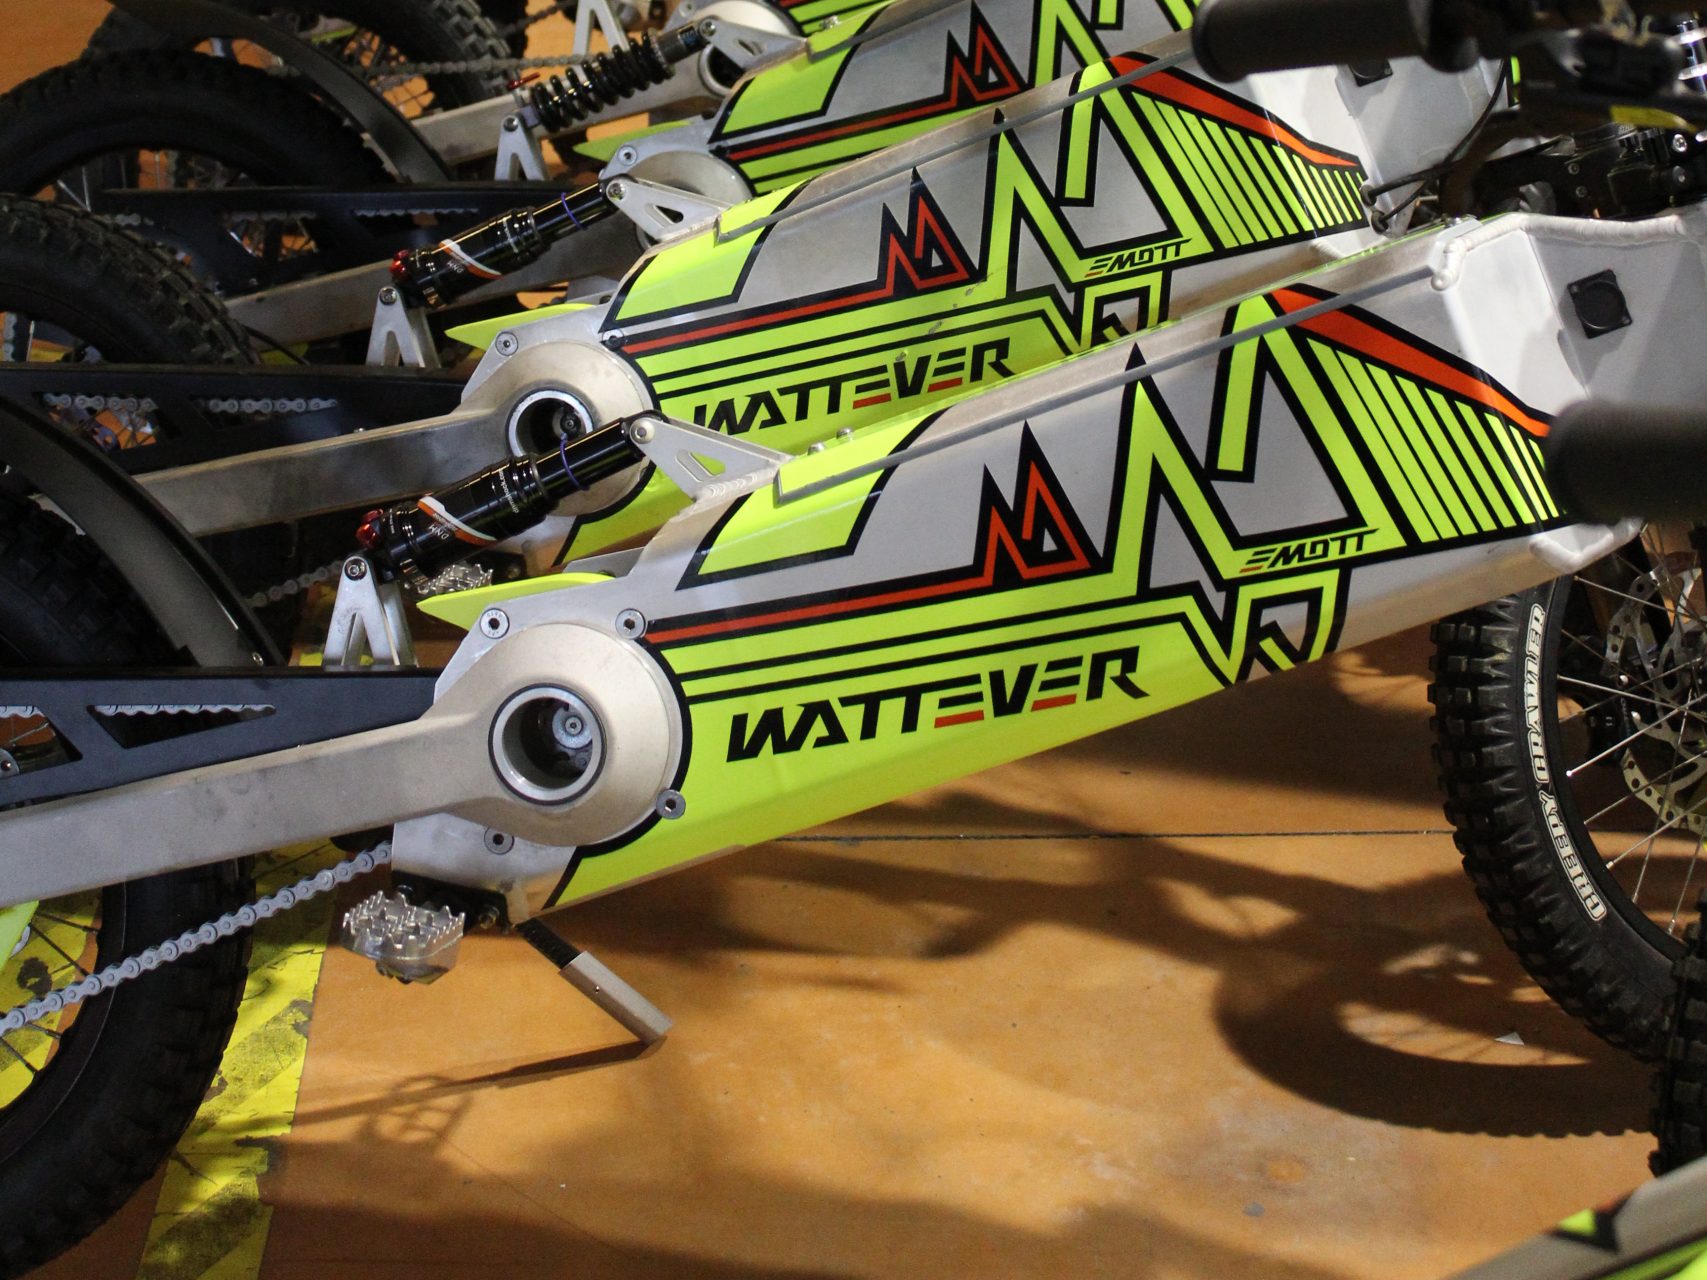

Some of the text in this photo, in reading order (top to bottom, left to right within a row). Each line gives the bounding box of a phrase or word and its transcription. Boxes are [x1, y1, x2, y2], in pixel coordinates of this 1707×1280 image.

[1084, 238, 1192, 278] EMOTT
[693, 337, 1016, 436] WATTEVER
[429, 524, 450, 541] DNM
[1239, 528, 1380, 574] EMOTT
[726, 645, 1151, 763] WATTEVER
[1524, 603, 1607, 921] CREEPY CRAWLER
